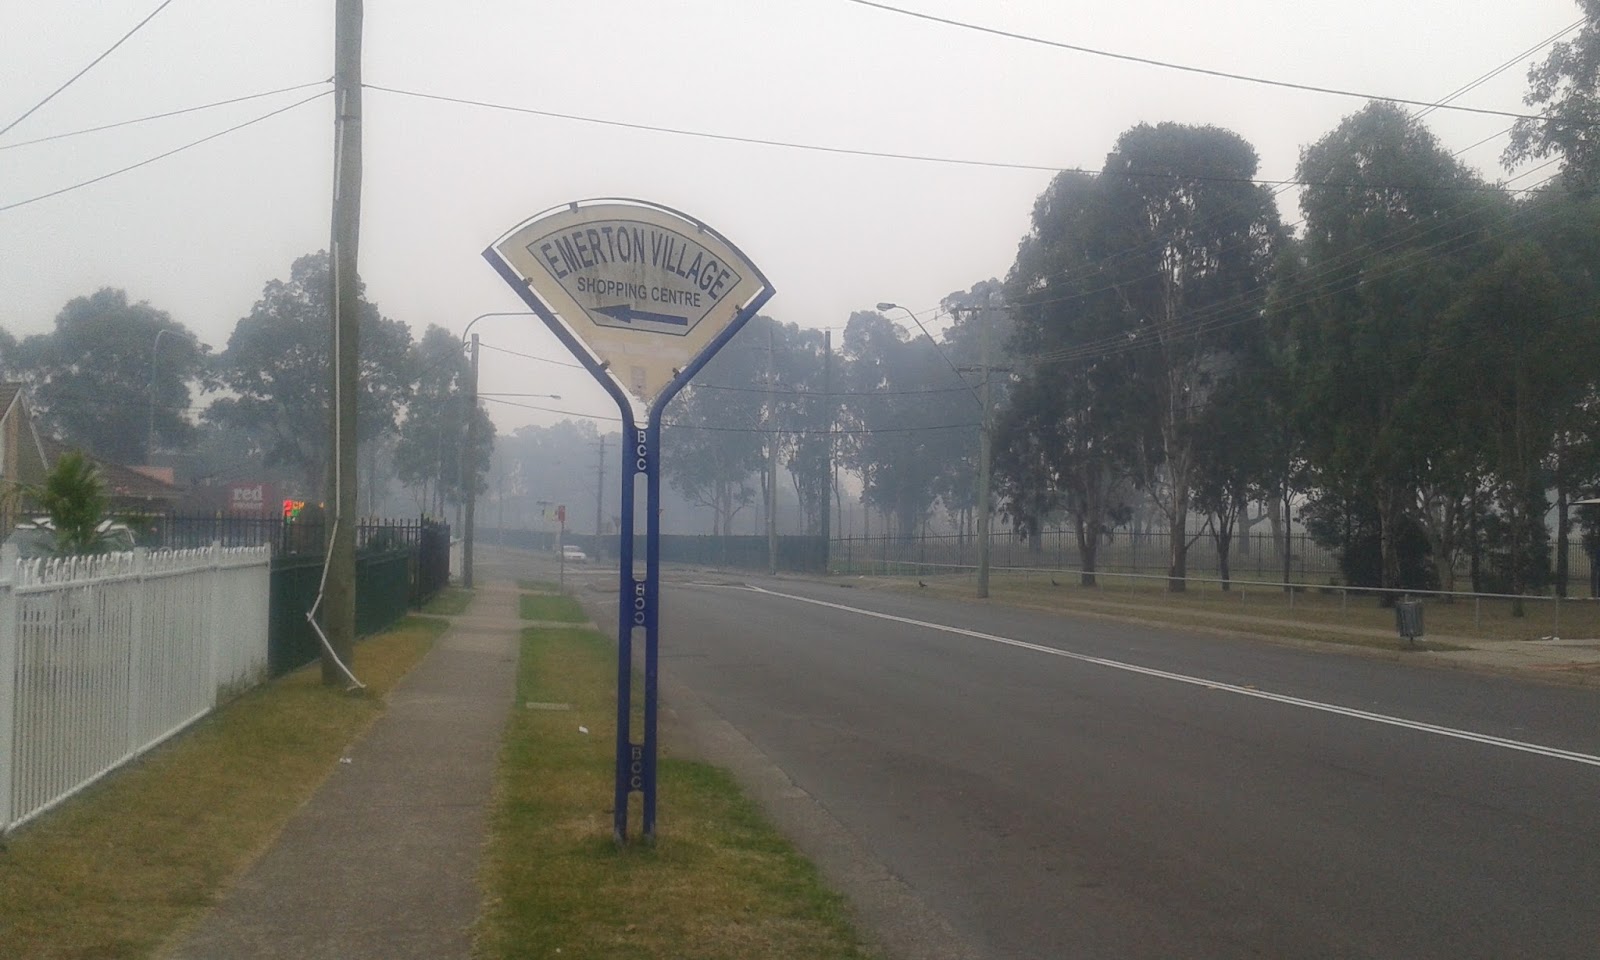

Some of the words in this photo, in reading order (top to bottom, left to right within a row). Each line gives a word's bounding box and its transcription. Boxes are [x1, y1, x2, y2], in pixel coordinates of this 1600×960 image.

[540, 226, 646, 279] EMERTON
[650, 231, 731, 300] VILLAGE
[576, 277, 648, 300] SHOPPING
[651, 286, 701, 308] CENTRE
[636, 430, 647, 471] BCC
